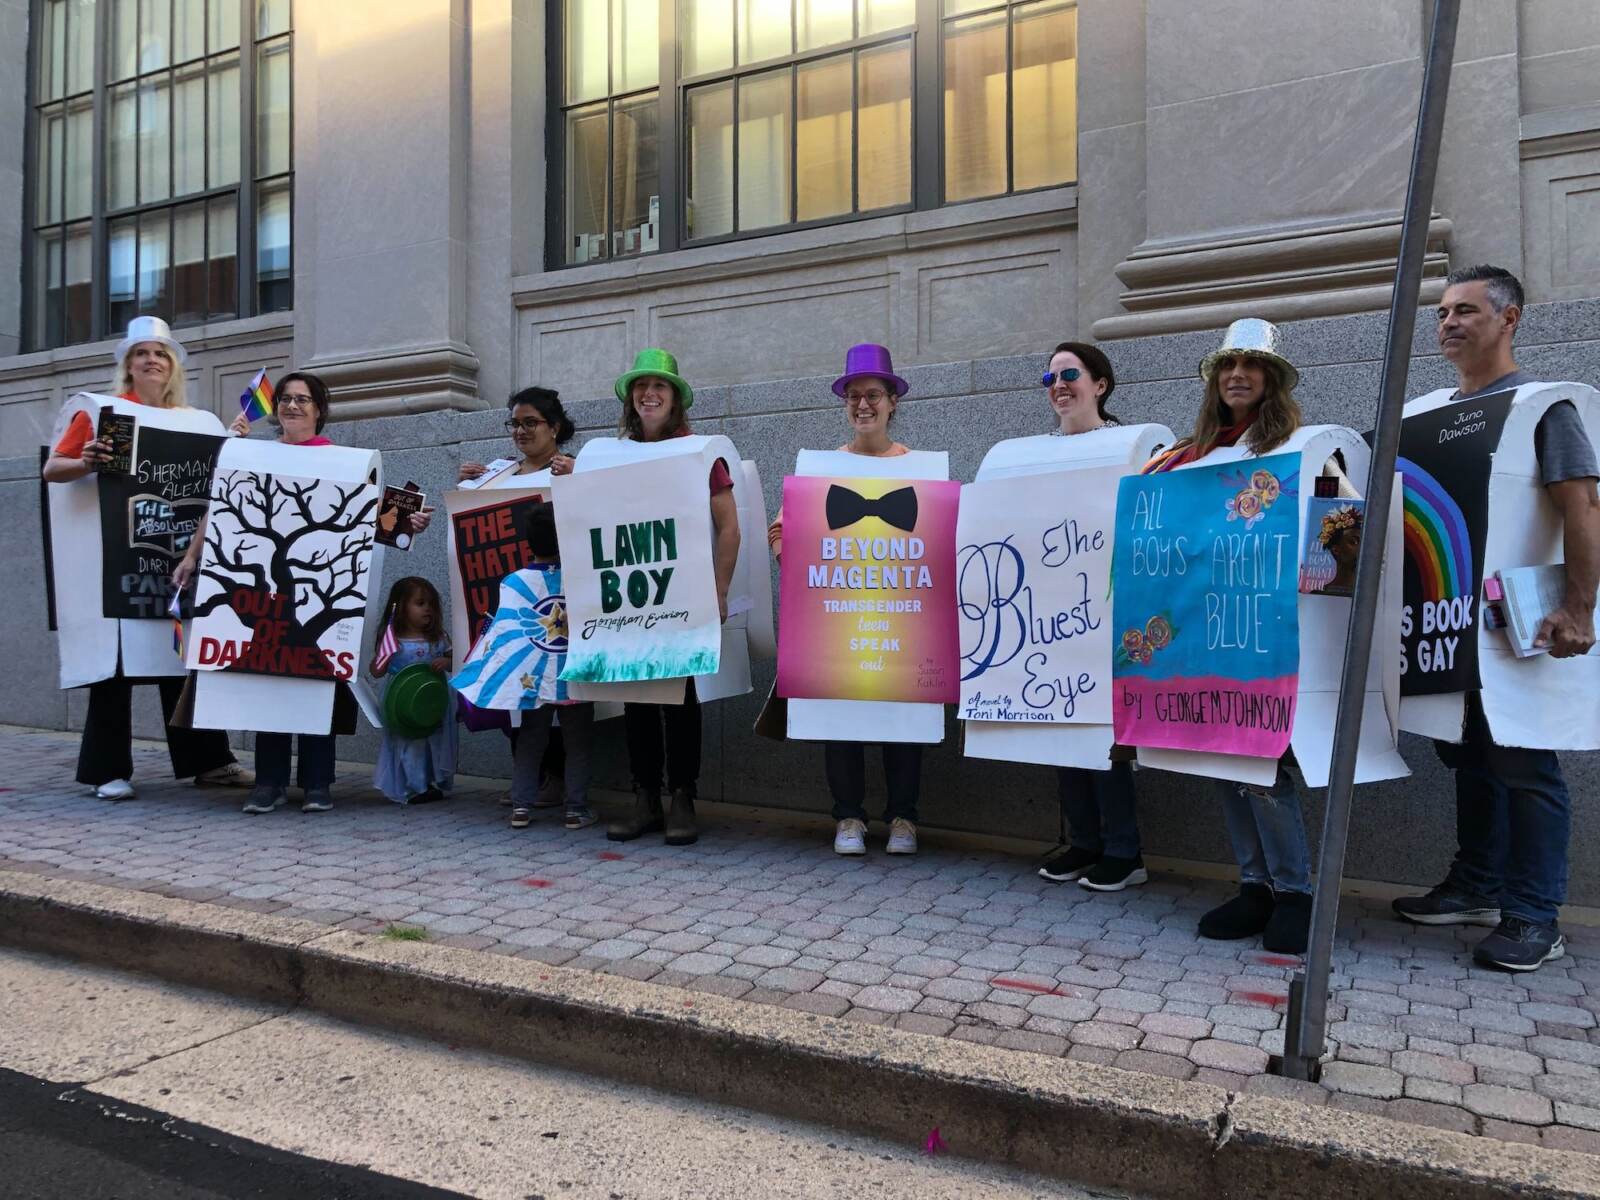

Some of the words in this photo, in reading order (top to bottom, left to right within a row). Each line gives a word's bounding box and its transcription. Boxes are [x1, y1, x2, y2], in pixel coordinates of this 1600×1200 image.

[1438, 420, 1486, 444] Dawson
[1454, 409, 1483, 425] Juno
[138, 455, 213, 484] SHERMAN
[135, 501, 175, 518] THE
[1131, 488, 1163, 531] ALL
[459, 507, 516, 547] THE
[590, 518, 677, 570] LAWN
[821, 537, 926, 561] BEYOND
[1041, 519, 1104, 567] The
[139, 557, 170, 574] DIARY
[807, 564, 933, 590] MAGENTA
[231, 590, 288, 616] OUT
[471, 585, 489, 616] U
[600, 567, 674, 613] BOY
[823, 600, 923, 613] TRANSGENDER
[958, 534, 1101, 682] Bluest
[1422, 595, 1474, 634] BOOK
[254, 619, 290, 646] OF
[1205, 592, 1272, 653] BLUE
[198, 636, 355, 682] DARKNESS
[849, 638, 901, 652] SPEAK
[1417, 635, 1459, 673] GAY
[1022, 652, 1096, 718] Eye
[966, 708, 993, 720] Toni
[997, 708, 1055, 721] Morrison
[1122, 685, 1143, 720] by
